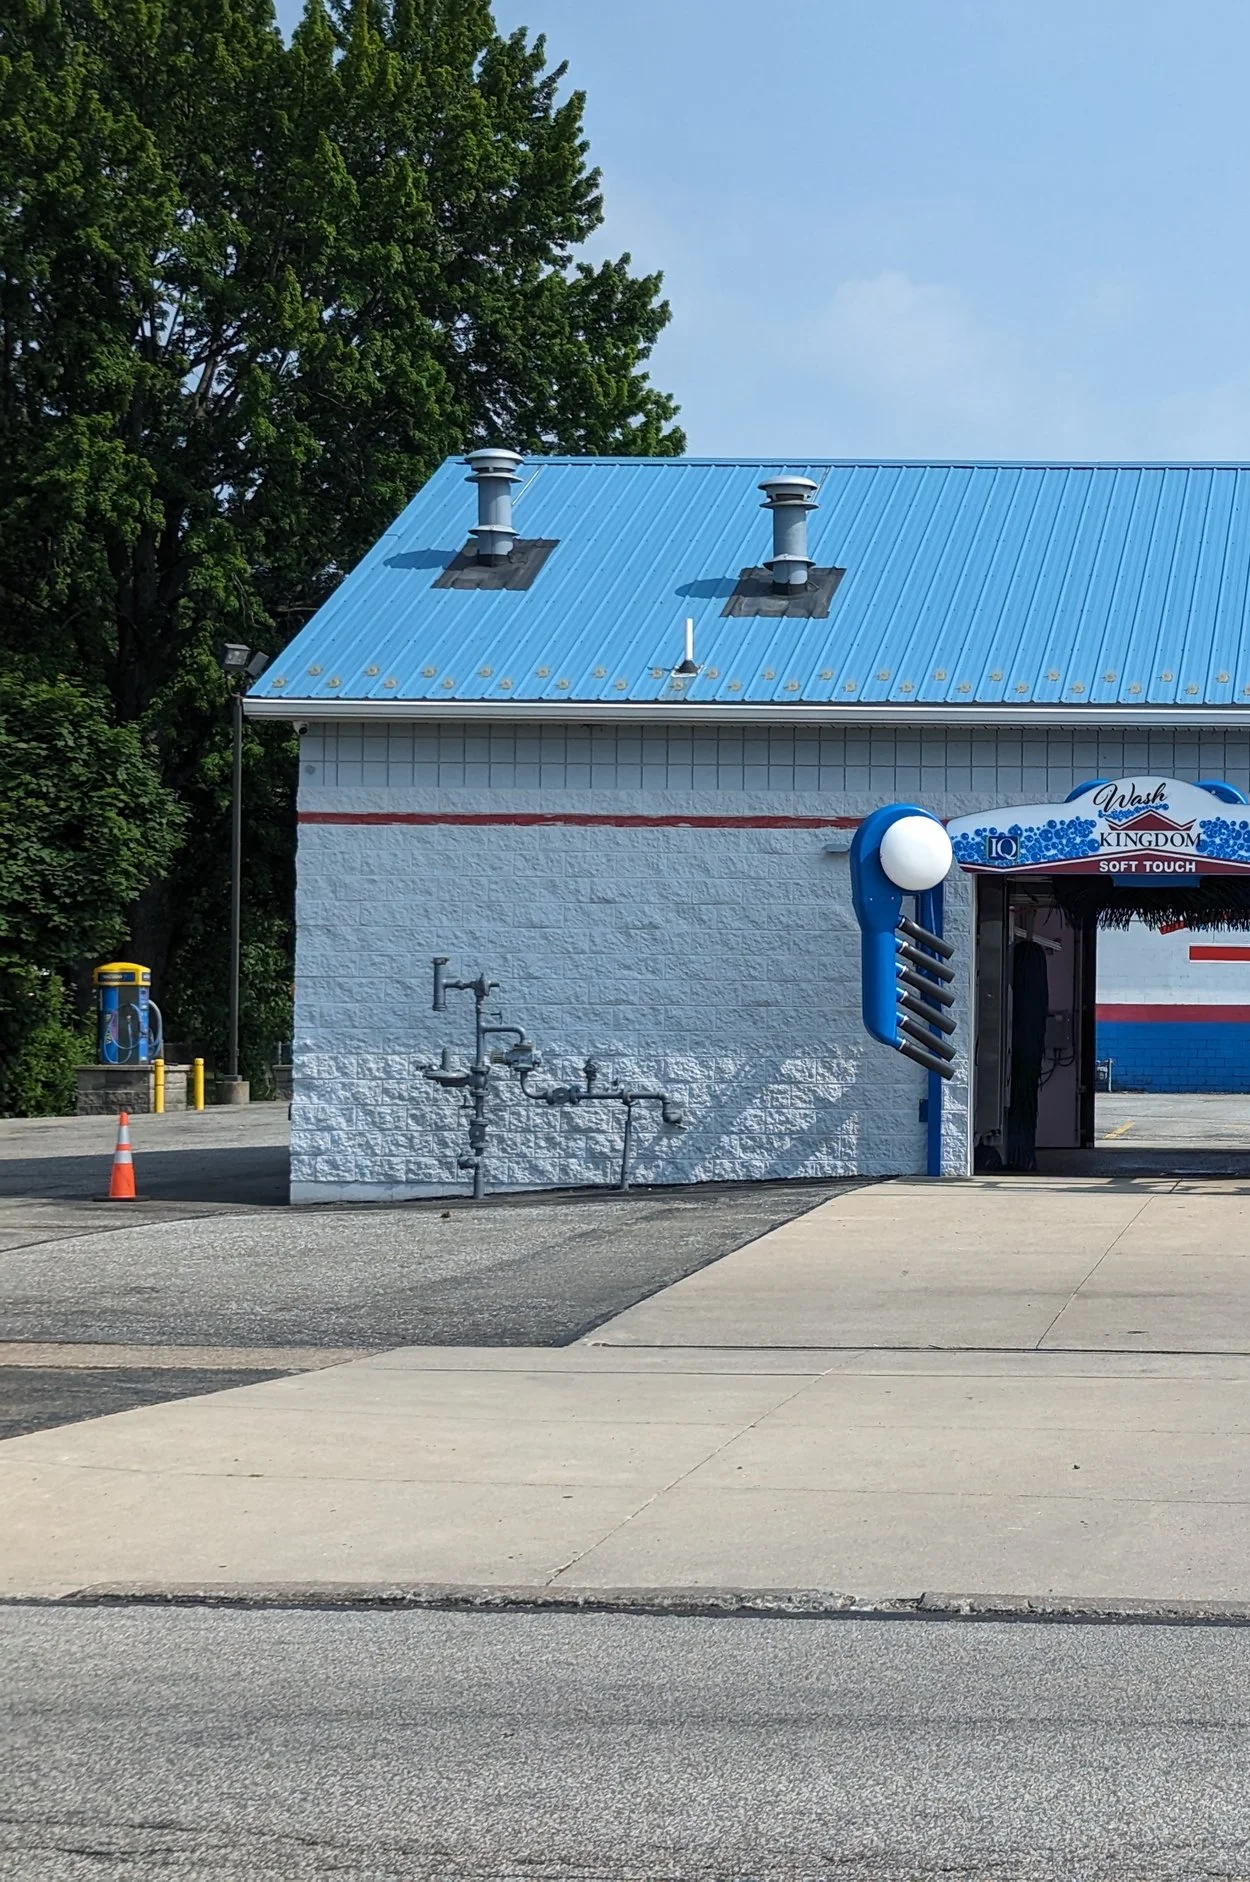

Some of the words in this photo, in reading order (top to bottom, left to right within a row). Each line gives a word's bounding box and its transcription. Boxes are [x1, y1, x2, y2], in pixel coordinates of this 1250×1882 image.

[1093, 782, 1168, 813] Wash
[990, 838, 1017, 860] IQ
[1100, 832, 1203, 848] KINGDOM
[1099, 861, 1139, 873] SOFT
[1143, 861, 1196, 873] TOUCH
